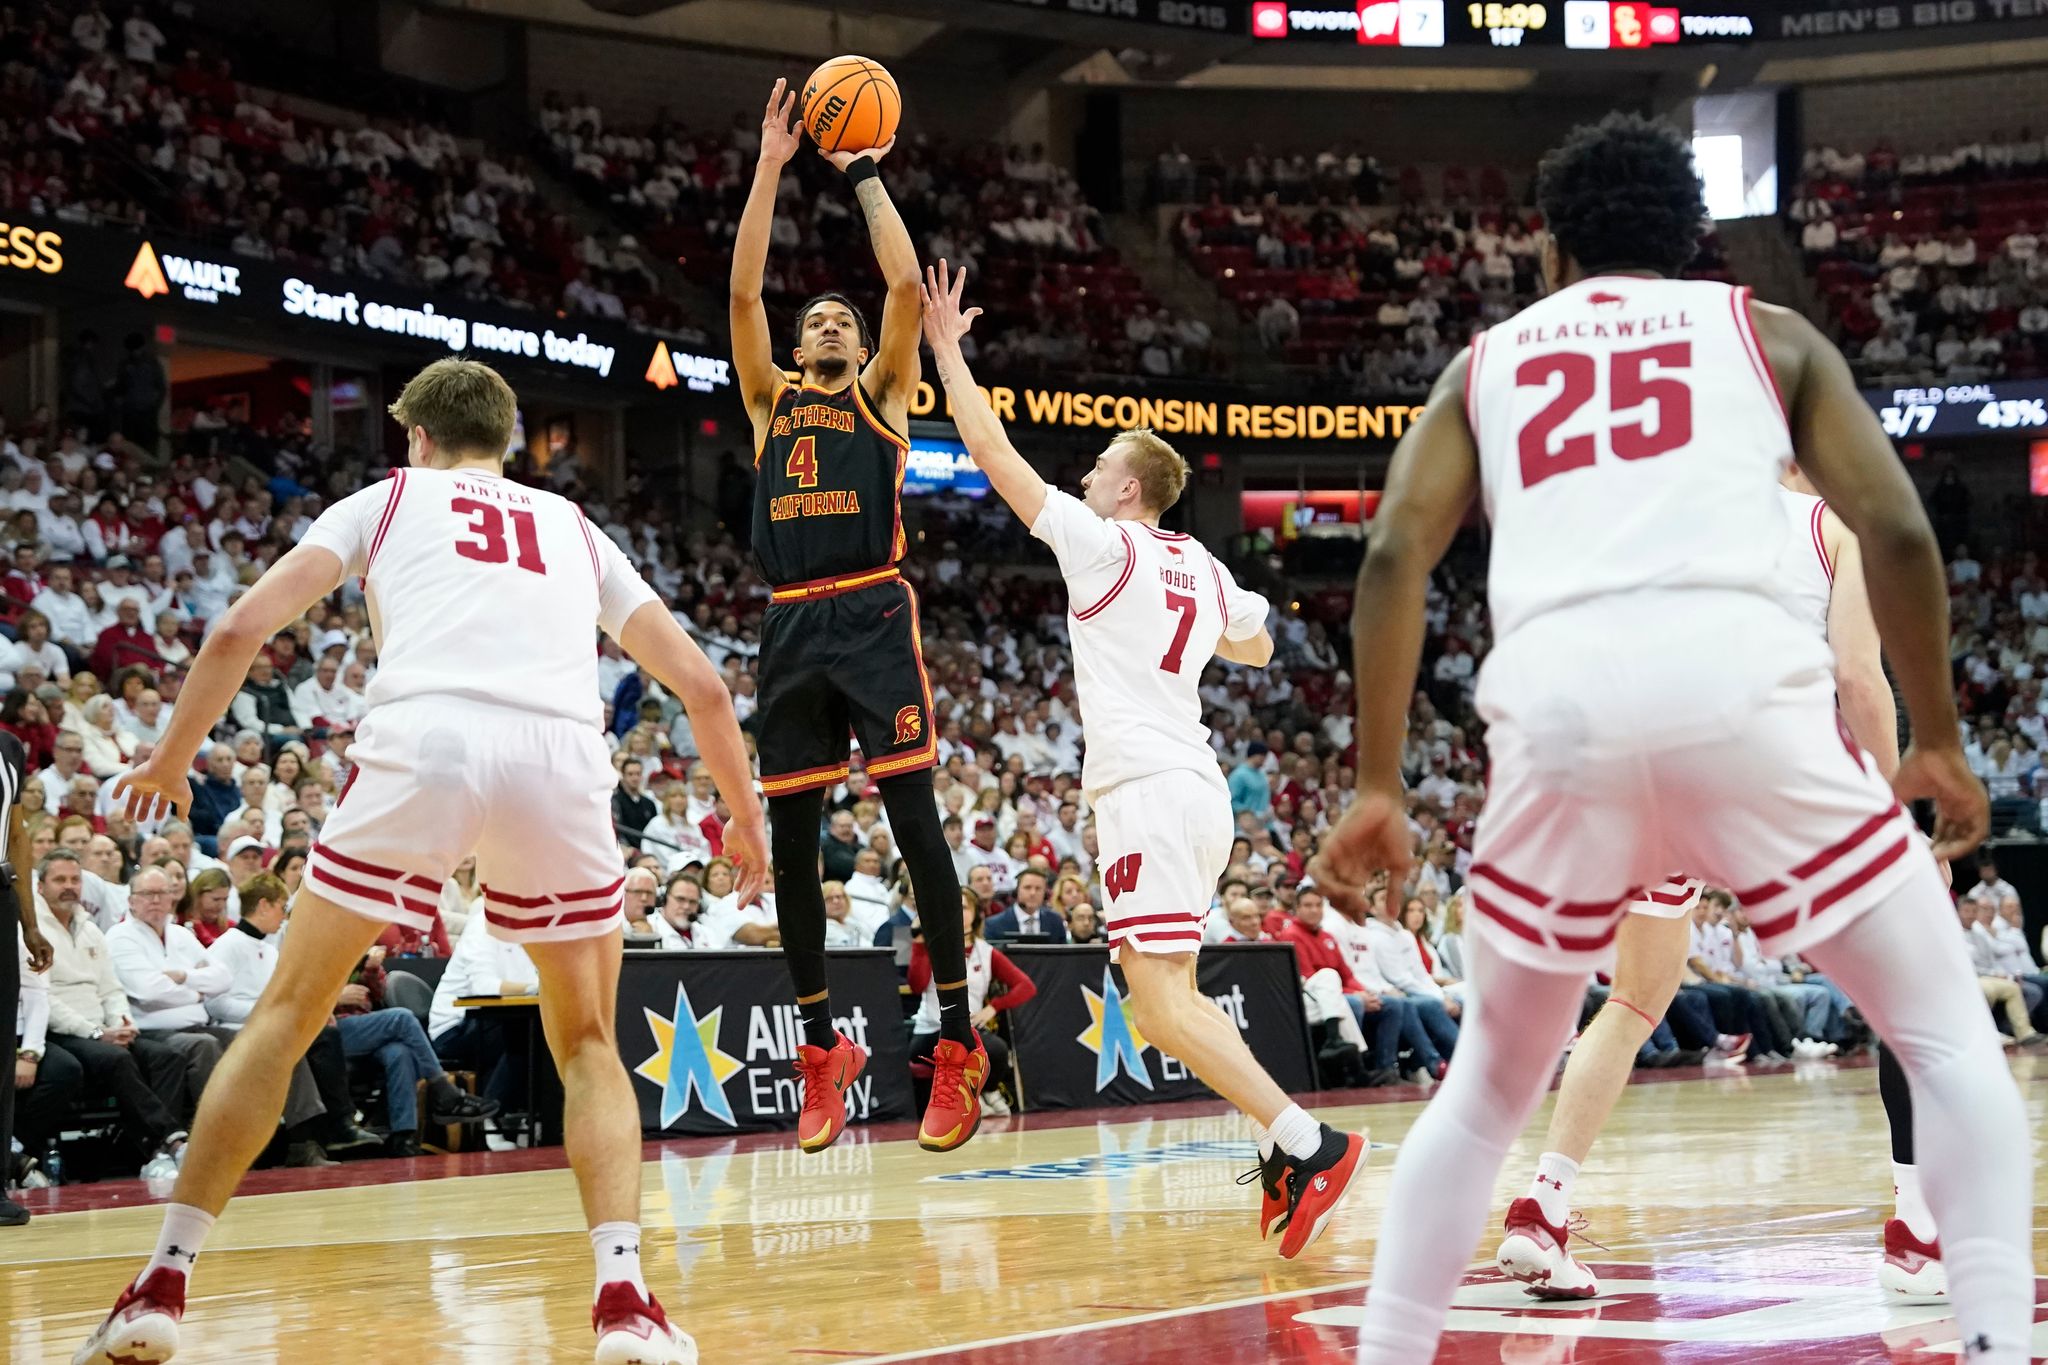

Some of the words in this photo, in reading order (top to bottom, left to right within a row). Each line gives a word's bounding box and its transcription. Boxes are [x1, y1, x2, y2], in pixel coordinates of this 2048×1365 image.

[1158, 1, 1227, 28] 2015
[1416, 13, 1428, 31] 7
[1582, 15, 1595, 34] 9
[1781, 6, 1900, 37] MEN'S
[1912, 1, 1976, 26] BIG
[813, 95, 848, 145] Wilso
[282, 278, 360, 325] Start
[363, 302, 467, 351] earning
[472, 320, 540, 357] more
[542, 329, 616, 378] today
[1516, 311, 1693, 346] BLACKWELL
[1024, 388, 1218, 434] WISCONSIN
[1945, 384, 1997, 404] GOAL
[772, 404, 855, 438] STHERN
[1515, 341, 1692, 489] 25
[786, 435, 818, 488] 4
[452, 481, 532, 505] WINTER
[451, 497, 547, 576] 31
[1159, 566, 1197, 591] ROHDE
[1159, 588, 1198, 675] 7
[1105, 852, 1143, 904] W
[746, 1004, 872, 1061] Allint
